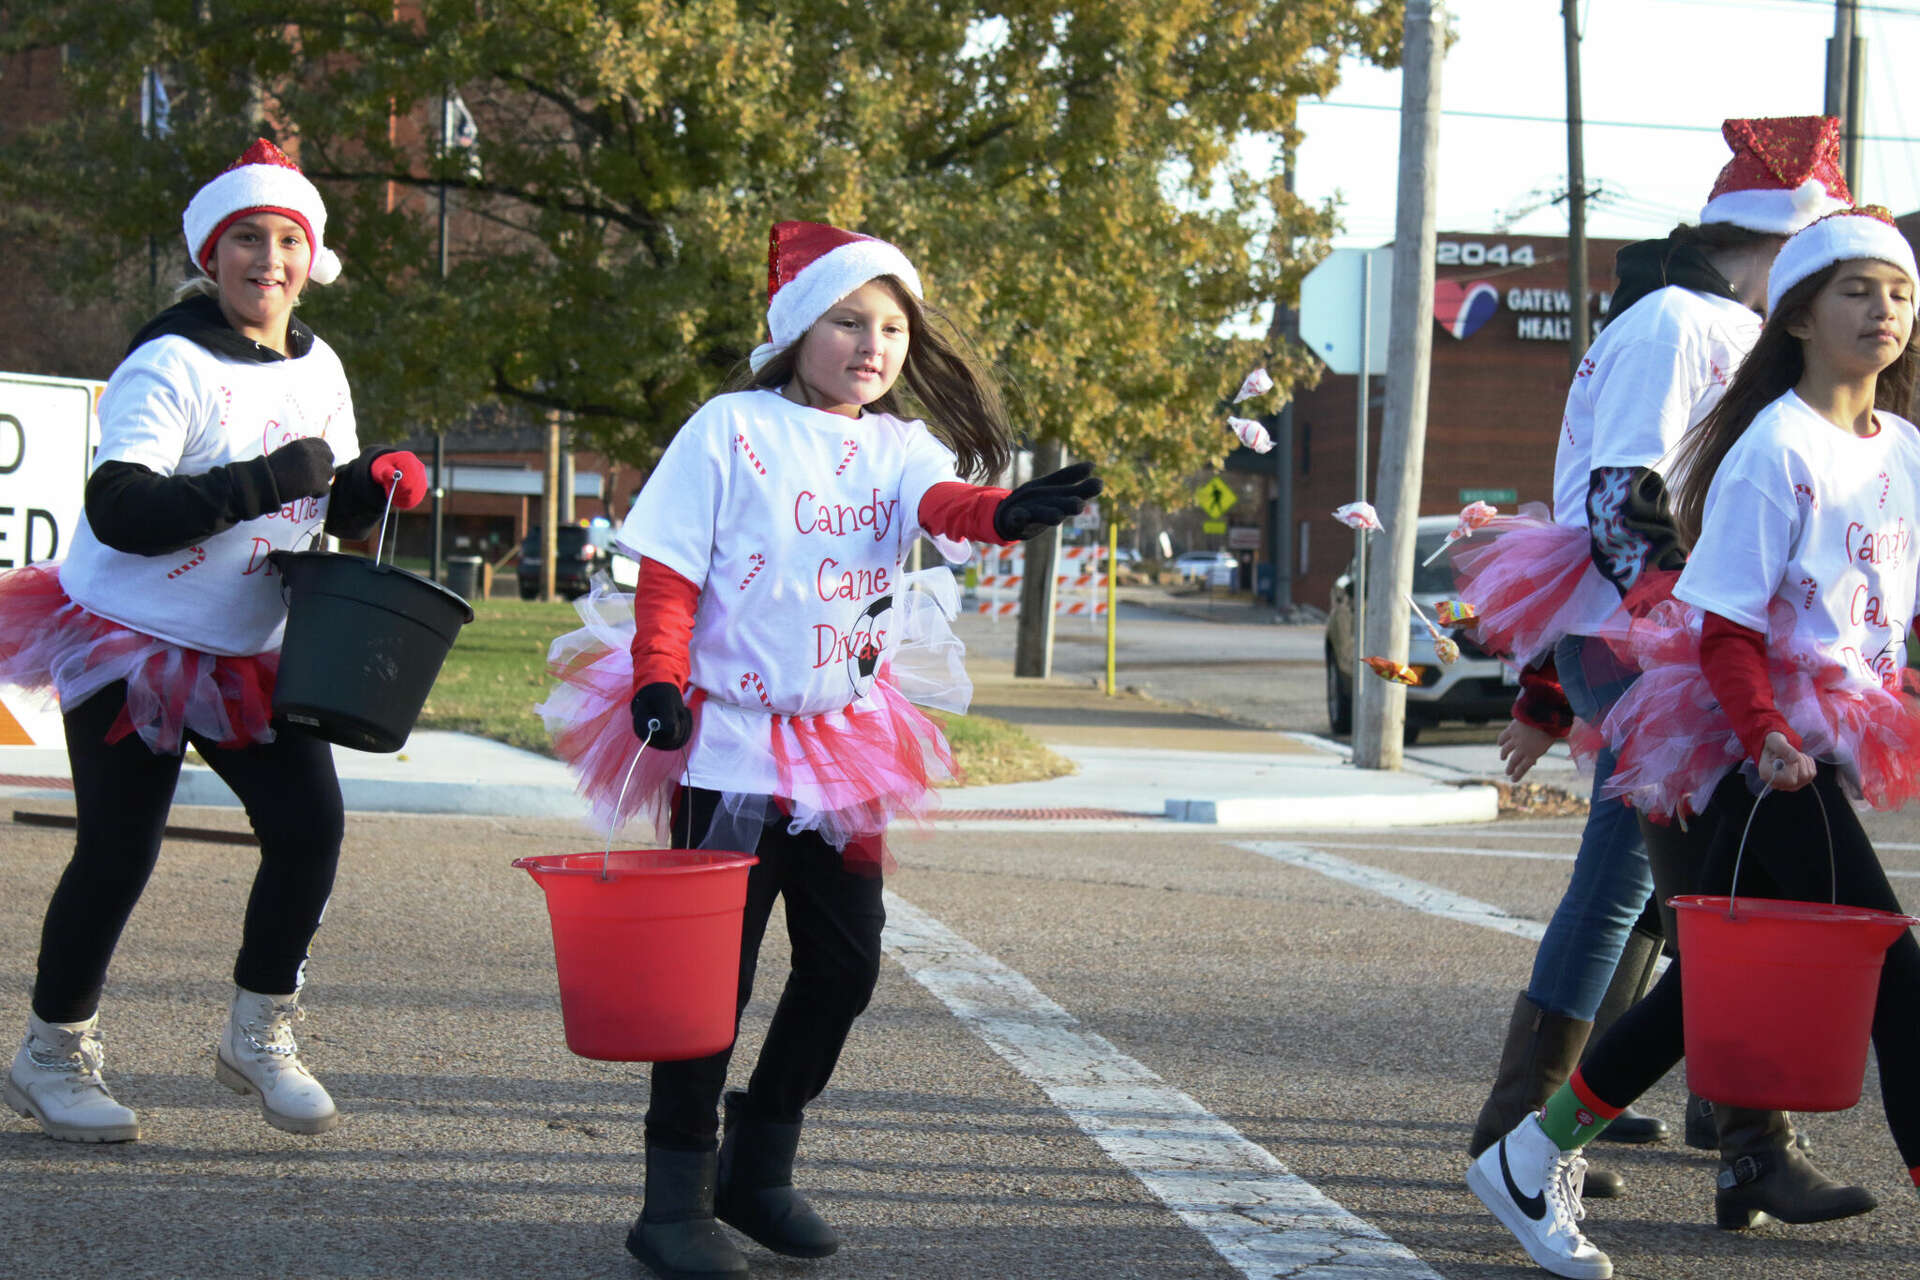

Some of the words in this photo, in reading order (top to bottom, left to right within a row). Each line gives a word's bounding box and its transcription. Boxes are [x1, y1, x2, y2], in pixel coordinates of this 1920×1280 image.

[1436, 241, 1536, 267] 2044
[1507, 286, 1592, 313] GATEW
[1517, 316, 1571, 340] HEALT
[265, 495, 320, 524] ane
[794, 488, 898, 543] Candy
[816, 557, 891, 602] Cane
[812, 623, 888, 670] Divas
